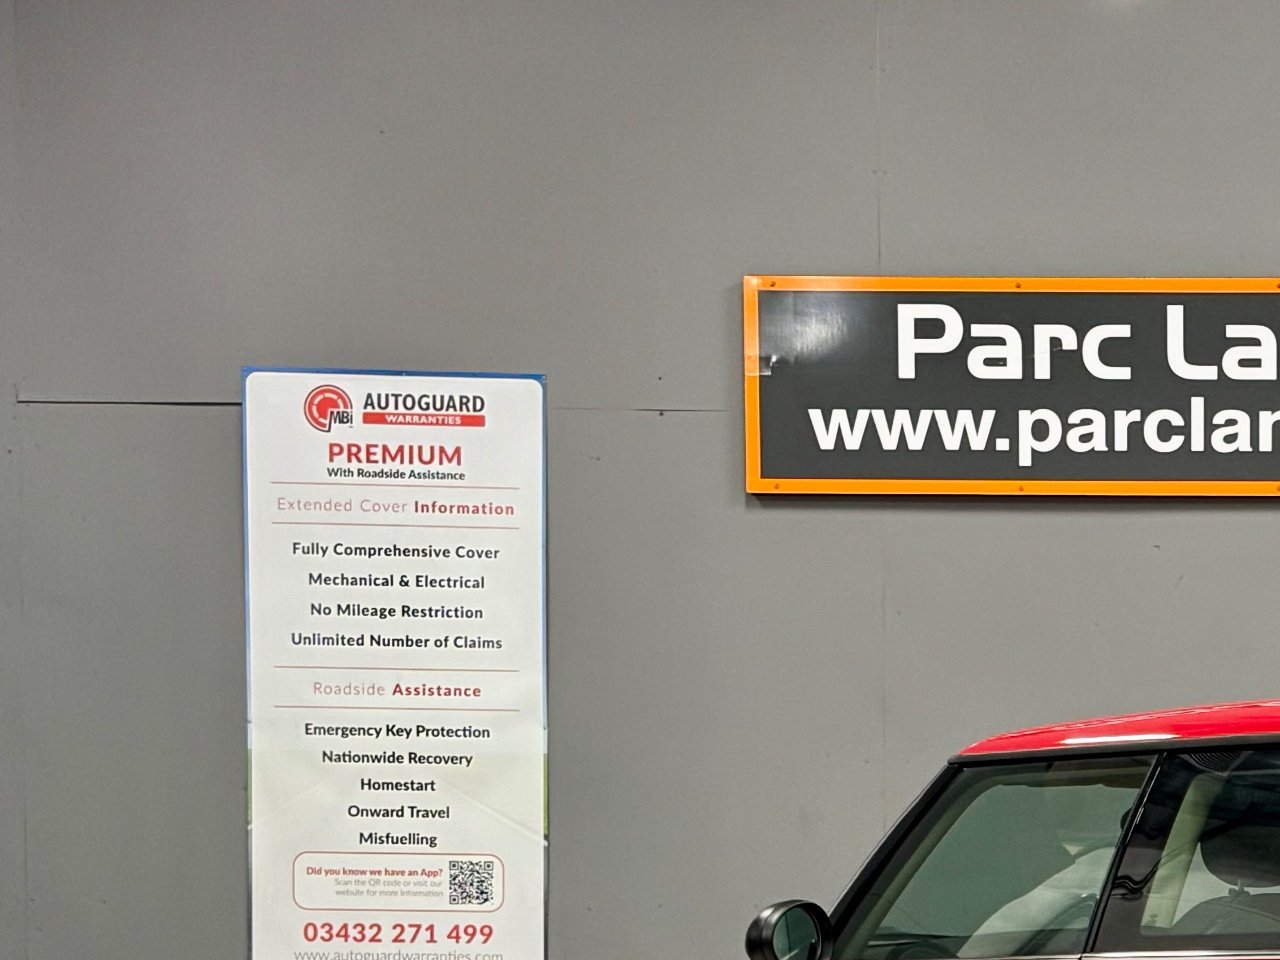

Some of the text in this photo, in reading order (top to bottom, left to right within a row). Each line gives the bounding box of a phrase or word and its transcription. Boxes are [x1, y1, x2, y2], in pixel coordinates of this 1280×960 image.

[898, 303, 1131, 380] Parc
[363, 393, 485, 412] AUTOGUARD
[385, 414, 462, 425] WARRANTIES
[328, 443, 462, 466] PREMIUM
[327, 467, 466, 480] With Roadside Assistance
[277, 497, 514, 516] Extended Cover Information
[292, 542, 500, 560] Fully Comprehensive Cover
[308, 573, 485, 589] Mechanical & Electrical
[310, 603, 483, 619] No Mileage Restriction
[291, 632, 503, 649] Unlimited Number of Claims
[313, 682, 481, 697] Roadside Assistance
[305, 723, 490, 740] Emergency Key Protection
[322, 750, 473, 767] Nationwide Recovery
[360, 778, 436, 792] Homestart
[347, 805, 450, 819] Onward Travel
[359, 832, 437, 848] Misfuelling
[306, 866, 322, 875] Did
[324, 868, 340, 877] you
[342, 867, 367, 876] know
[384, 868, 405, 877] have
[407, 869, 418, 877] an
[420, 868, 443, 878] App?
[334, 878, 352, 886] Scan
[354, 878, 366, 886] the
[368, 878, 381, 887] QR
[383, 879, 401, 887] code
[430, 880, 442, 888] our
[335, 888, 364, 896] website
[367, 888, 377, 897] for
[379, 889, 398, 897] more
[303, 922, 494, 945] 03432 271 499
